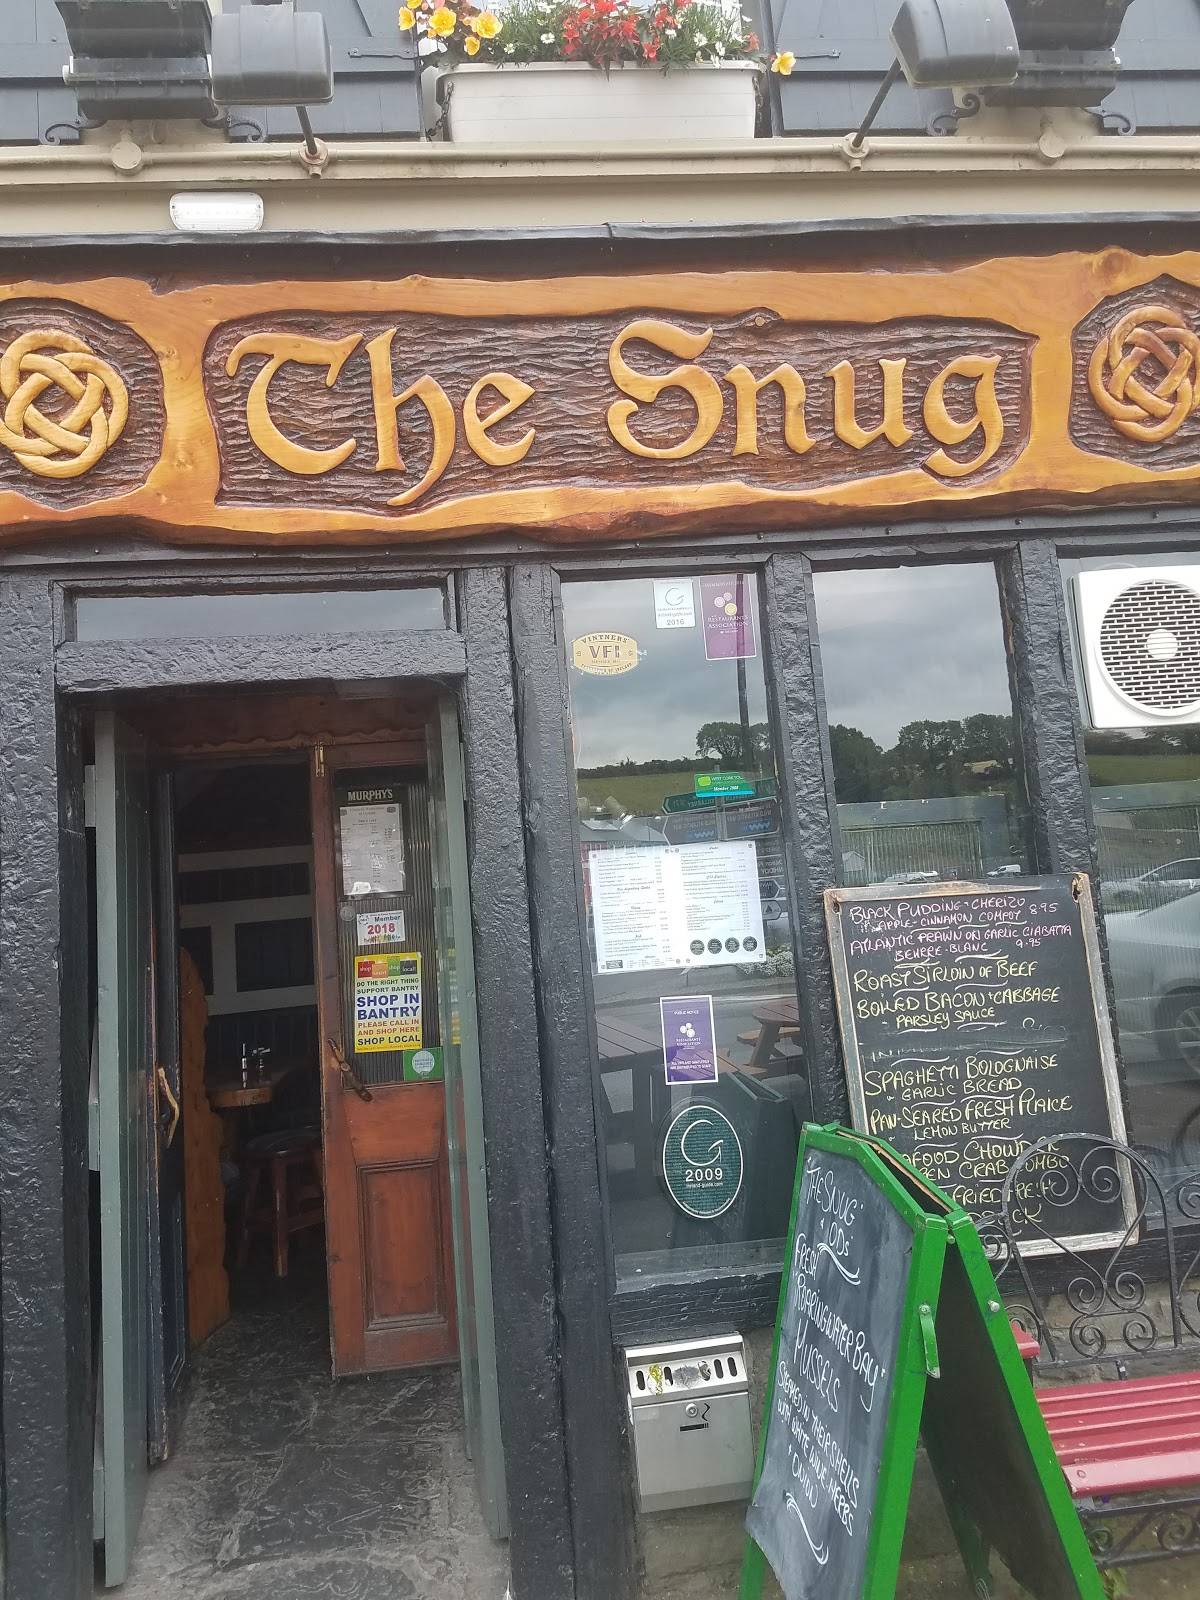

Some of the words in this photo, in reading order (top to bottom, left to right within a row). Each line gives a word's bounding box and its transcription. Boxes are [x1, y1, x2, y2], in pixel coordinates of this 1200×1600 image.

[225, 328, 536, 505] The
[607, 319, 1004, 478] Snug
[589, 645, 620, 659] VFI
[347, 789, 393, 801] MURPHY'S
[850, 904, 895, 924] BLACK
[920, 913, 972, 926] CINNAMON
[367, 922, 396, 935] 2018
[850, 934, 915, 956] ATLANTIC
[918, 930, 961, 943] PRAWN
[966, 930, 980, 941] ON
[984, 925, 1019, 940] GARLIC
[1023, 923, 1072, 937] CIABATTA
[853, 968, 910, 992] ROAST
[913, 963, 975, 985] SIRLOIN
[979, 966, 993, 978] OF
[997, 960, 1038, 978] BEEF
[356, 995, 398, 1007] SHOP
[404, 993, 420, 1004] IN
[856, 997, 920, 1019] BOILED
[925, 992, 985, 1012] BACON
[357, 1005, 420, 1020] BANTRY
[896, 1011, 950, 1029] PARSLEY
[953, 1007, 995, 1023] SAUCE
[357, 1037, 385, 1046] SHOP
[388, 1035, 421, 1044] LOCAL
[376, 1027, 397, 1035] SHOP
[864, 1064, 959, 1096] SPAGHETTI
[965, 1051, 1058, 1079] BOLOGNAISE
[901, 1084, 955, 1101] GARLIC
[963, 1077, 1022, 1096] BREAD
[964, 1099, 1014, 1120] FRESH
[1018, 1088, 1073, 1116] PLAICE
[914, 1122, 957, 1140] LEMON
[961, 1118, 1011, 1134] BUTTER
[685, 1167, 723, 1182] 2009
[959, 1160, 1010, 1178] CRAB
[795, 1233, 819, 1280] FRESH
[794, 1318, 840, 1413] MUSSELS
[812, 1410, 831, 1457] THEIR
[830, 1440, 859, 1509] SHELLS
[792, 1452, 819, 1508] ONION
